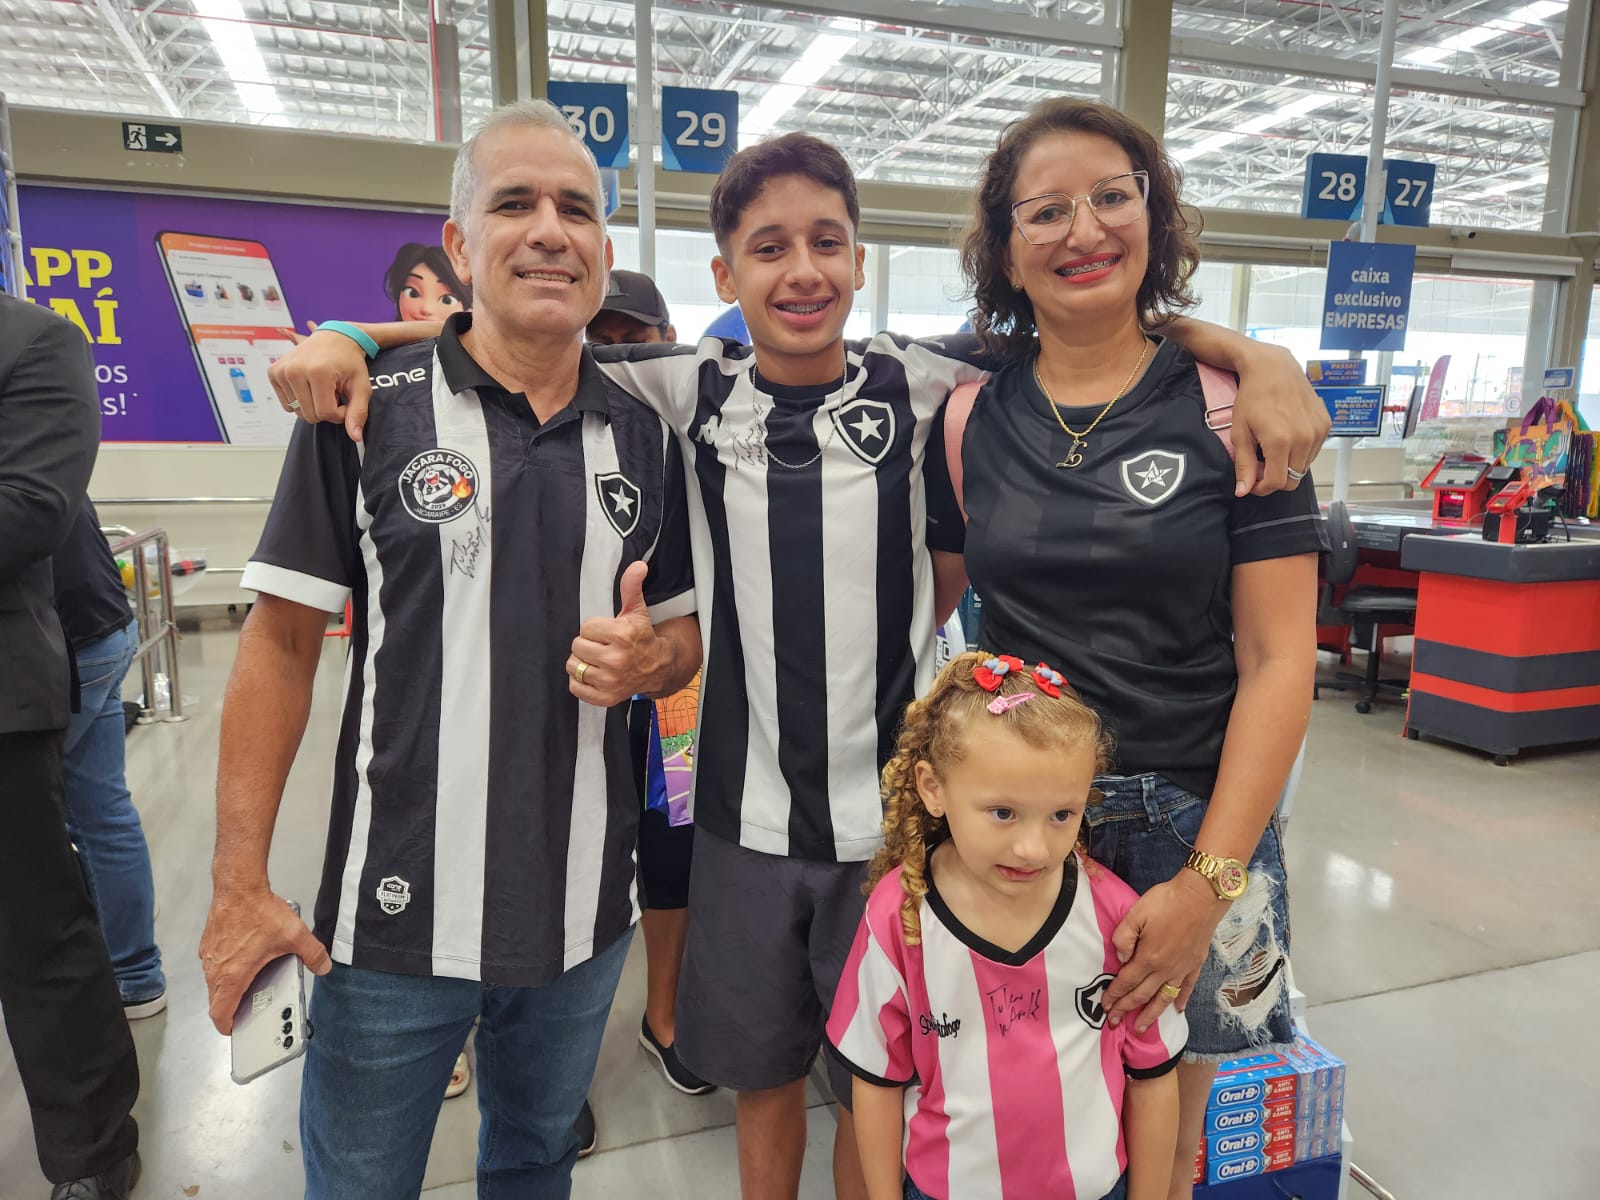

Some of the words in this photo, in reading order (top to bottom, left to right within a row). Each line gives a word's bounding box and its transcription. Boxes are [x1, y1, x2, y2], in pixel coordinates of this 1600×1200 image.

[676, 110, 726, 148] 29
[1318, 171, 1356, 202] 28
[1394, 178, 1427, 208] 27
[1351, 267, 1390, 284] caixa
[1334, 290, 1402, 308] exclusivo
[1325, 311, 1406, 330] EMPRESAS
[403, 453, 444, 484] JACARA
[446, 454, 473, 479] FOGO
[1220, 1087, 1258, 1103] Oral-B
[1219, 1111, 1256, 1127] Oral-B
[1220, 1136, 1258, 1152] Oral-B
[1221, 1160, 1258, 1176] Oral-B
